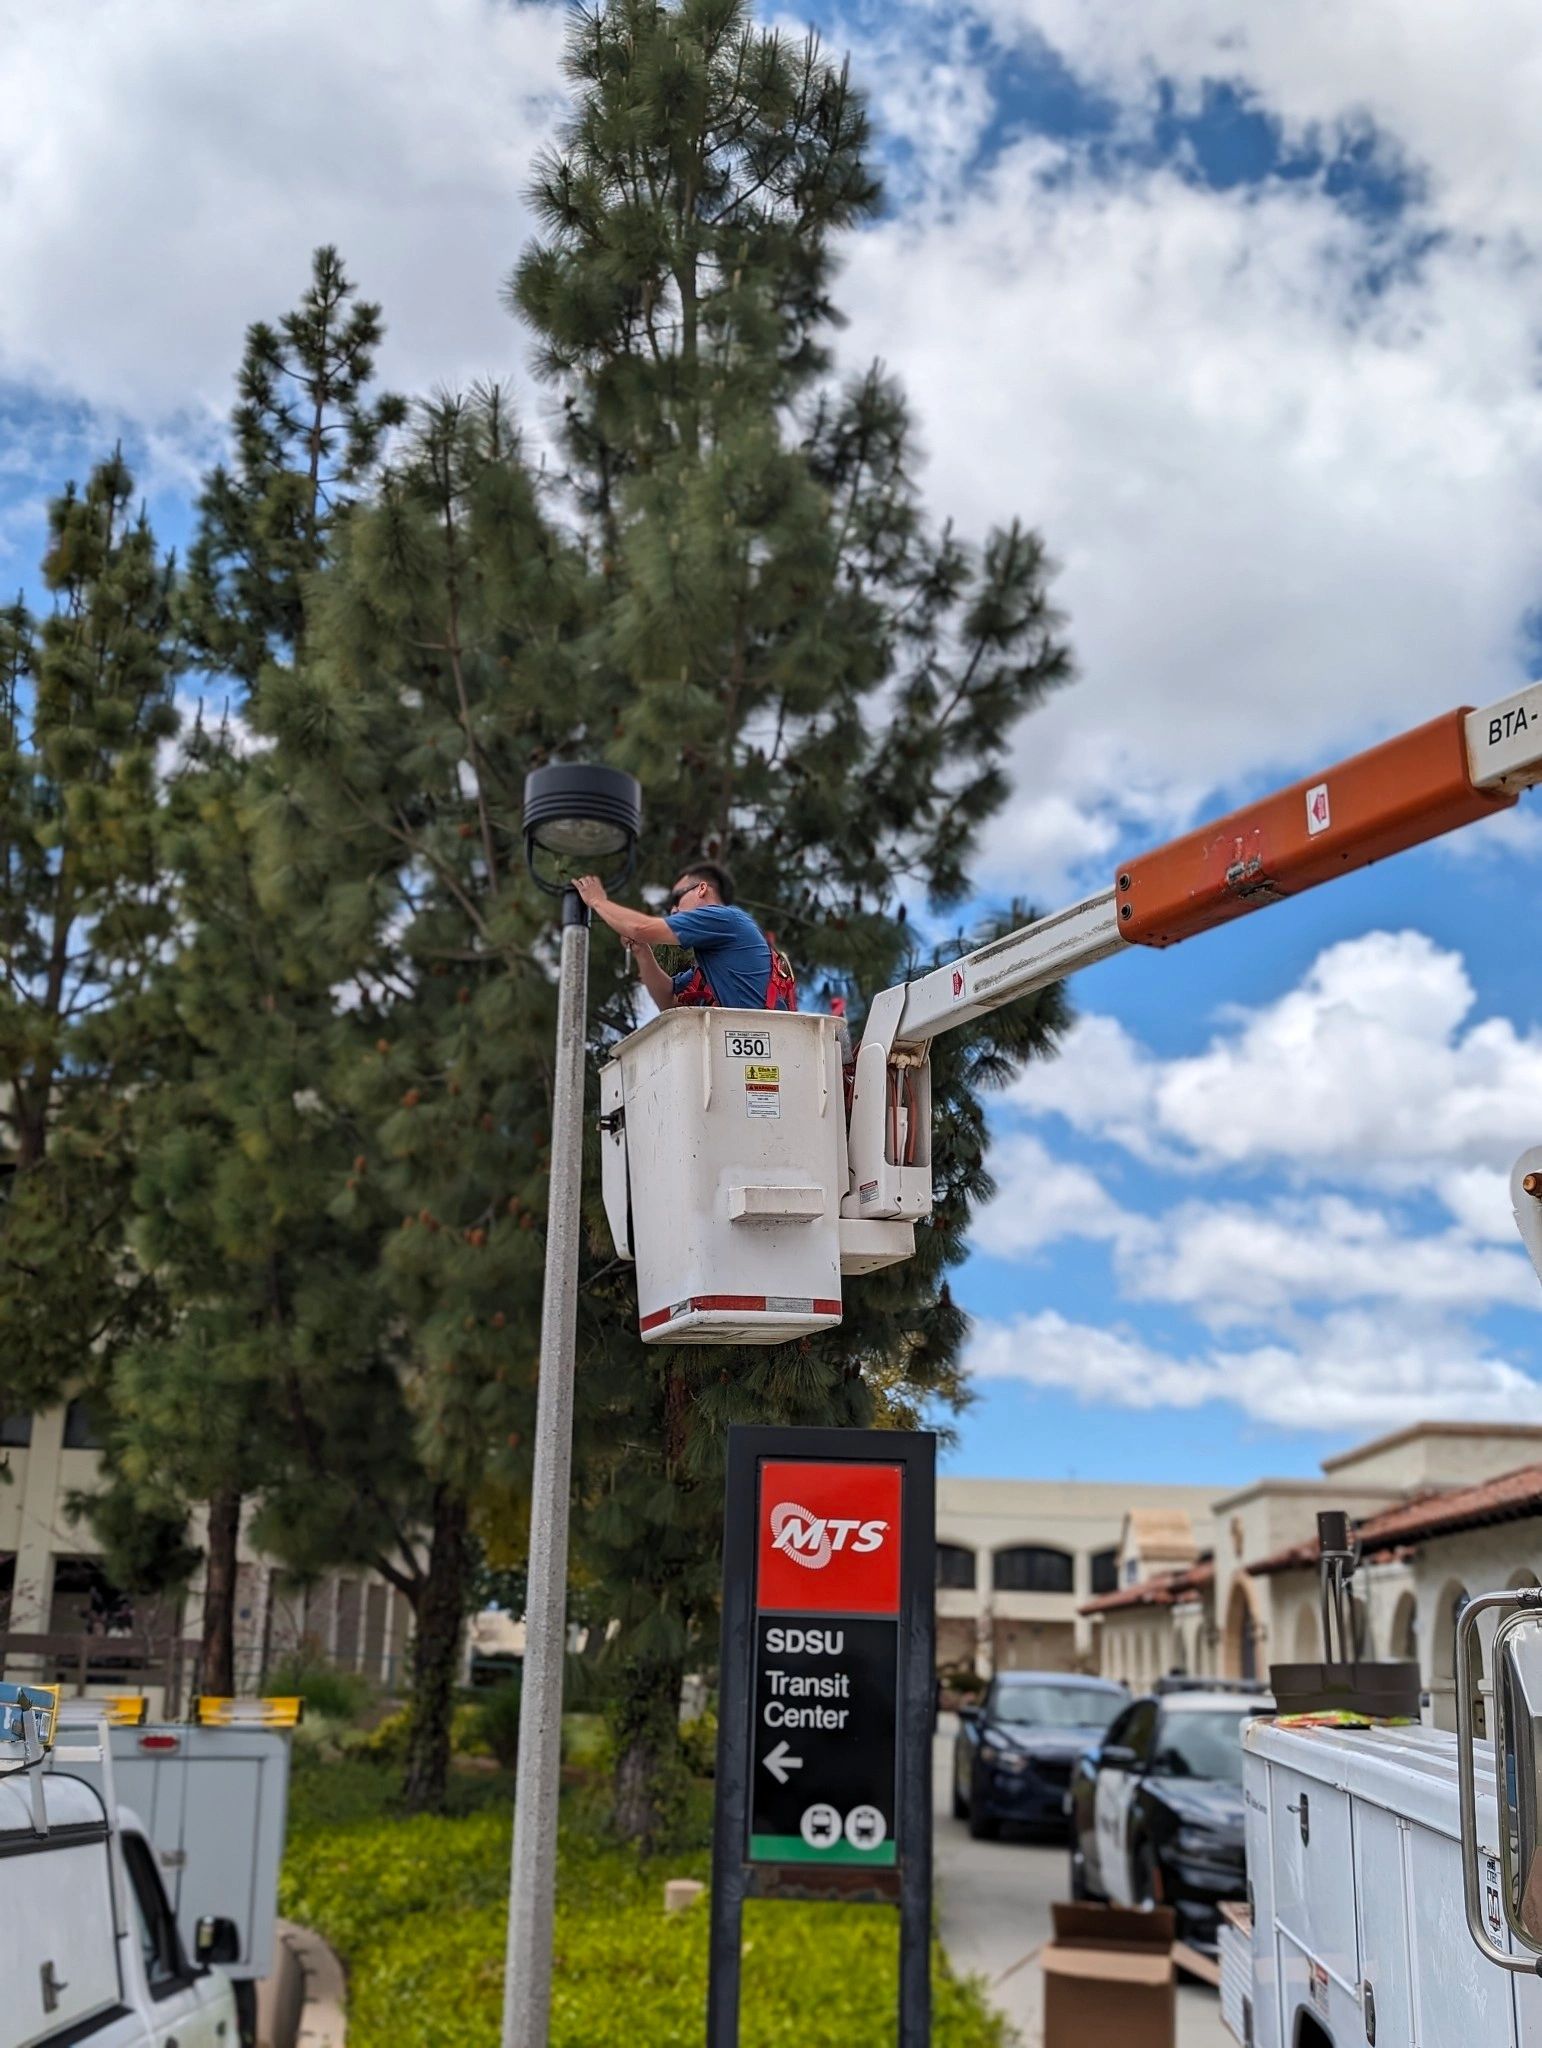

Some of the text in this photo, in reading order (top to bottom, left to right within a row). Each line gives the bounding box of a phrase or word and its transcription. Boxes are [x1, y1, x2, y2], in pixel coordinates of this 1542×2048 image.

[1489, 706, 1538, 746] BTA-
[732, 1038, 764, 1056] 350
[771, 1518, 888, 1553] MTS
[765, 1628, 844, 1655] SDSU
[765, 1670, 850, 1698] Transit
[764, 1701, 849, 1729] Center
